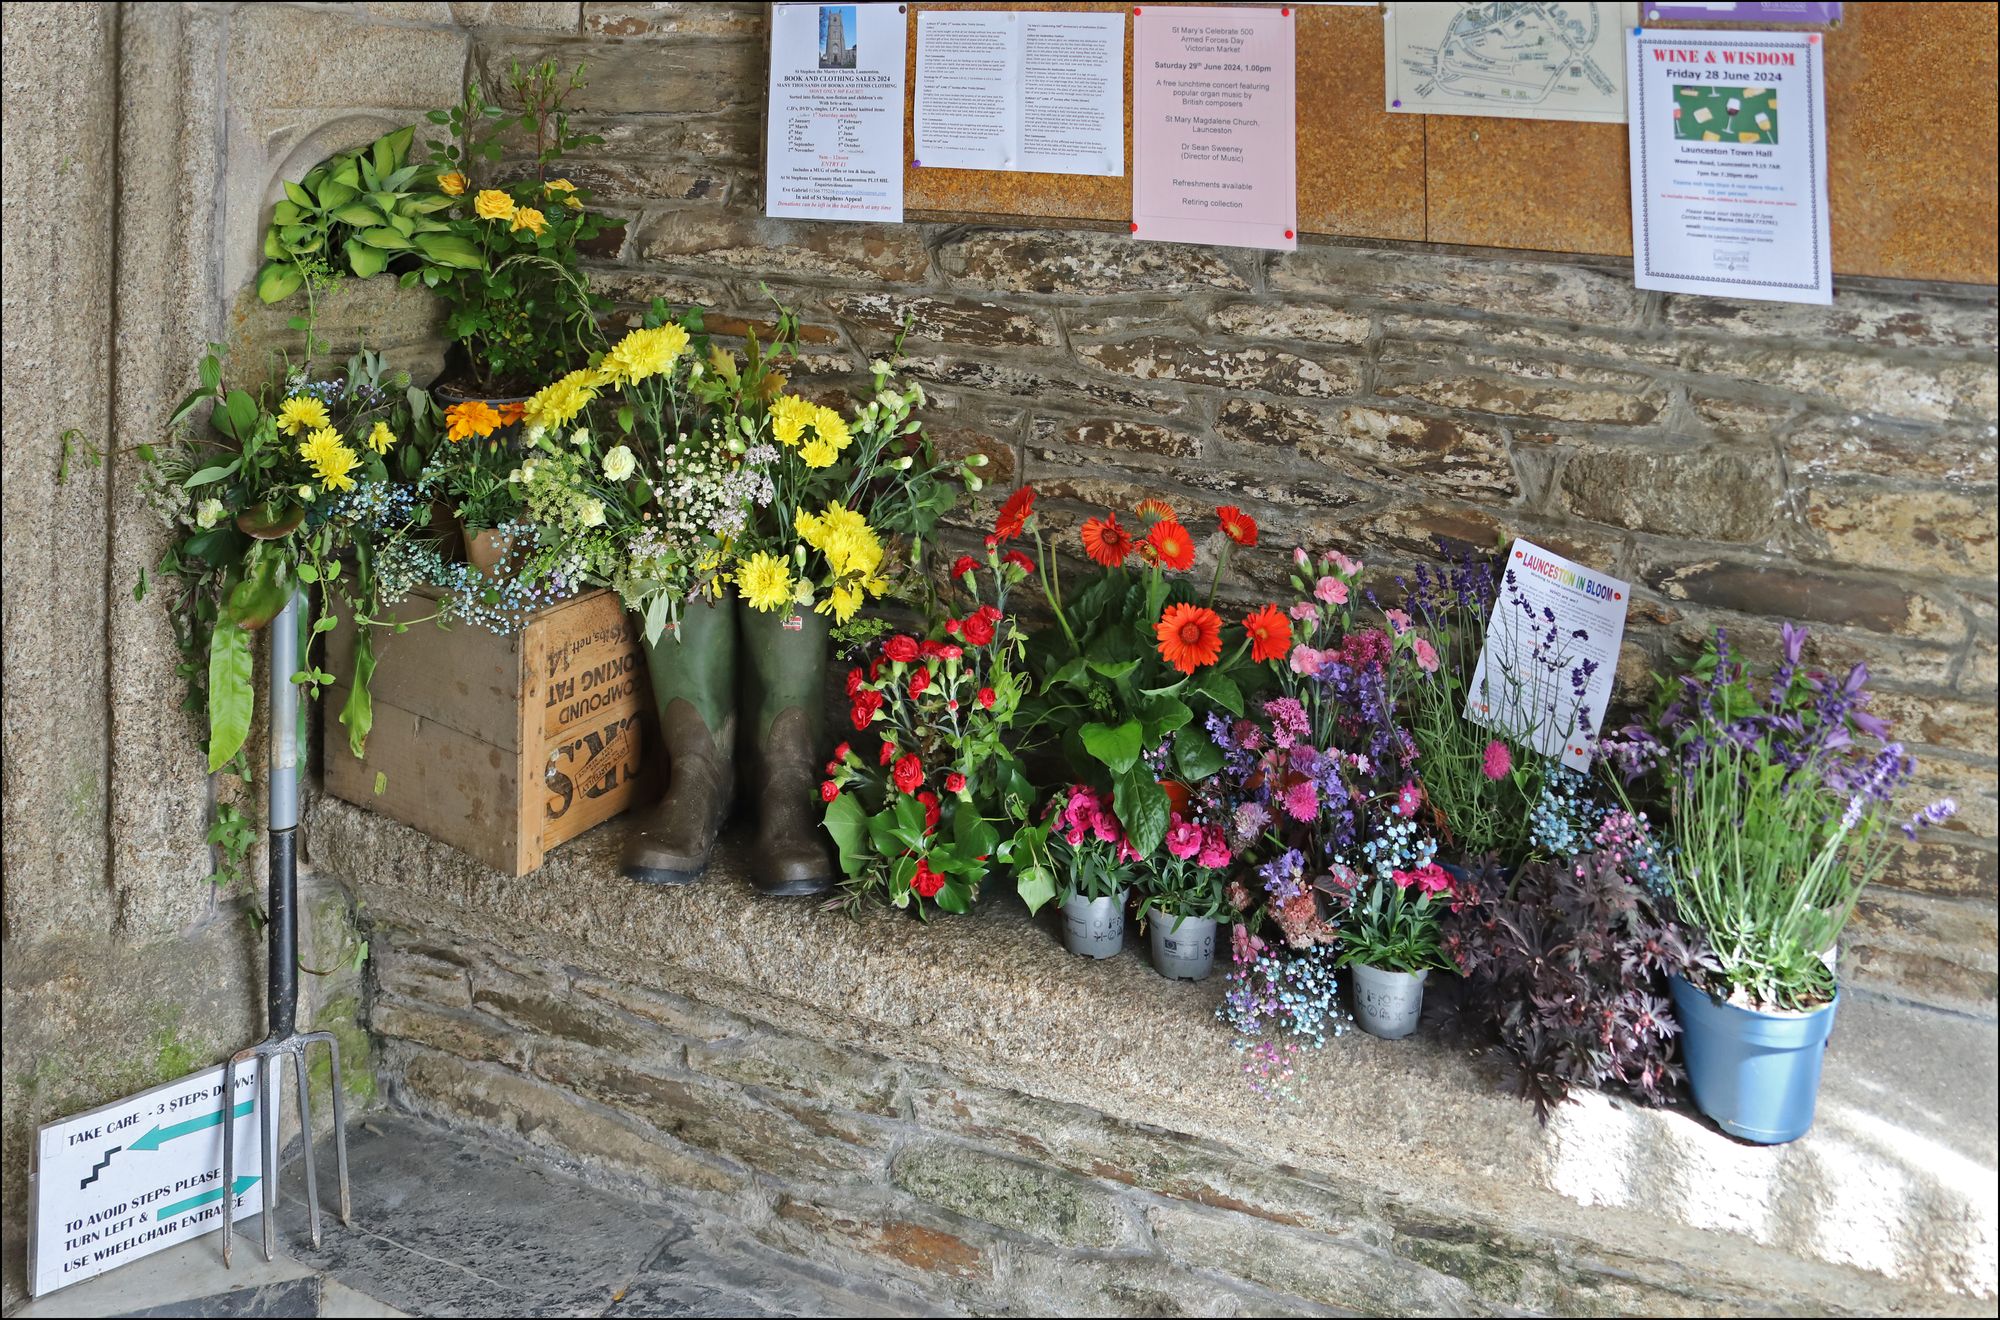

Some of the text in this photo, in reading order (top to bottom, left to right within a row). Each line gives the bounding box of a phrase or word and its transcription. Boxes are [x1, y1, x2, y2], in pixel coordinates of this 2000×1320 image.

[1181, 36, 1203, 44] Armed
[1231, 37, 1244, 45] Day
[1185, 45, 1214, 53] Victorian
[1653, 48, 1796, 66] WINE & WISDOM
[1155, 62, 1271, 73] Saturday 29th June 2024, 1.00pm
[1666, 69, 1782, 82] Friday 28 June 2024
[1239, 82, 1270, 91] featuring
[1173, 90, 1198, 98] popular
[1200, 90, 1220, 98] organ
[1222, 90, 1241, 98] music
[1205, 100, 1242, 108] composers
[1174, 116, 1191, 124] Mary
[1193, 117, 1231, 126] Magdalene
[1192, 126, 1232, 134] Launceston
[1211, 145, 1243, 154] Sweeney
[1681, 146, 1772, 157] Launceston Town Hall
[1181, 153, 1244, 163] (Director of Music)
[1172, 179, 1252, 191] Refreshments available
[1182, 198, 1242, 208] Retiring collection
[1523, 553, 1613, 601] LAUNCESTON IN BLOOM
[546, 676, 575, 708] FAT
[68, 1127, 102, 1146] TAKE
[107, 1112, 140, 1134] CARE
[157, 1104, 165, 1115] 3
[170, 1089, 209, 1110] STEPS
[65, 1168, 222, 1234] TO AVOID STEPS PLEASE
[65, 1212, 148, 1251] TURN LEFT &
[64, 1256, 89, 1273] USE
[94, 1223, 178, 1261] WHEELCHAIR
